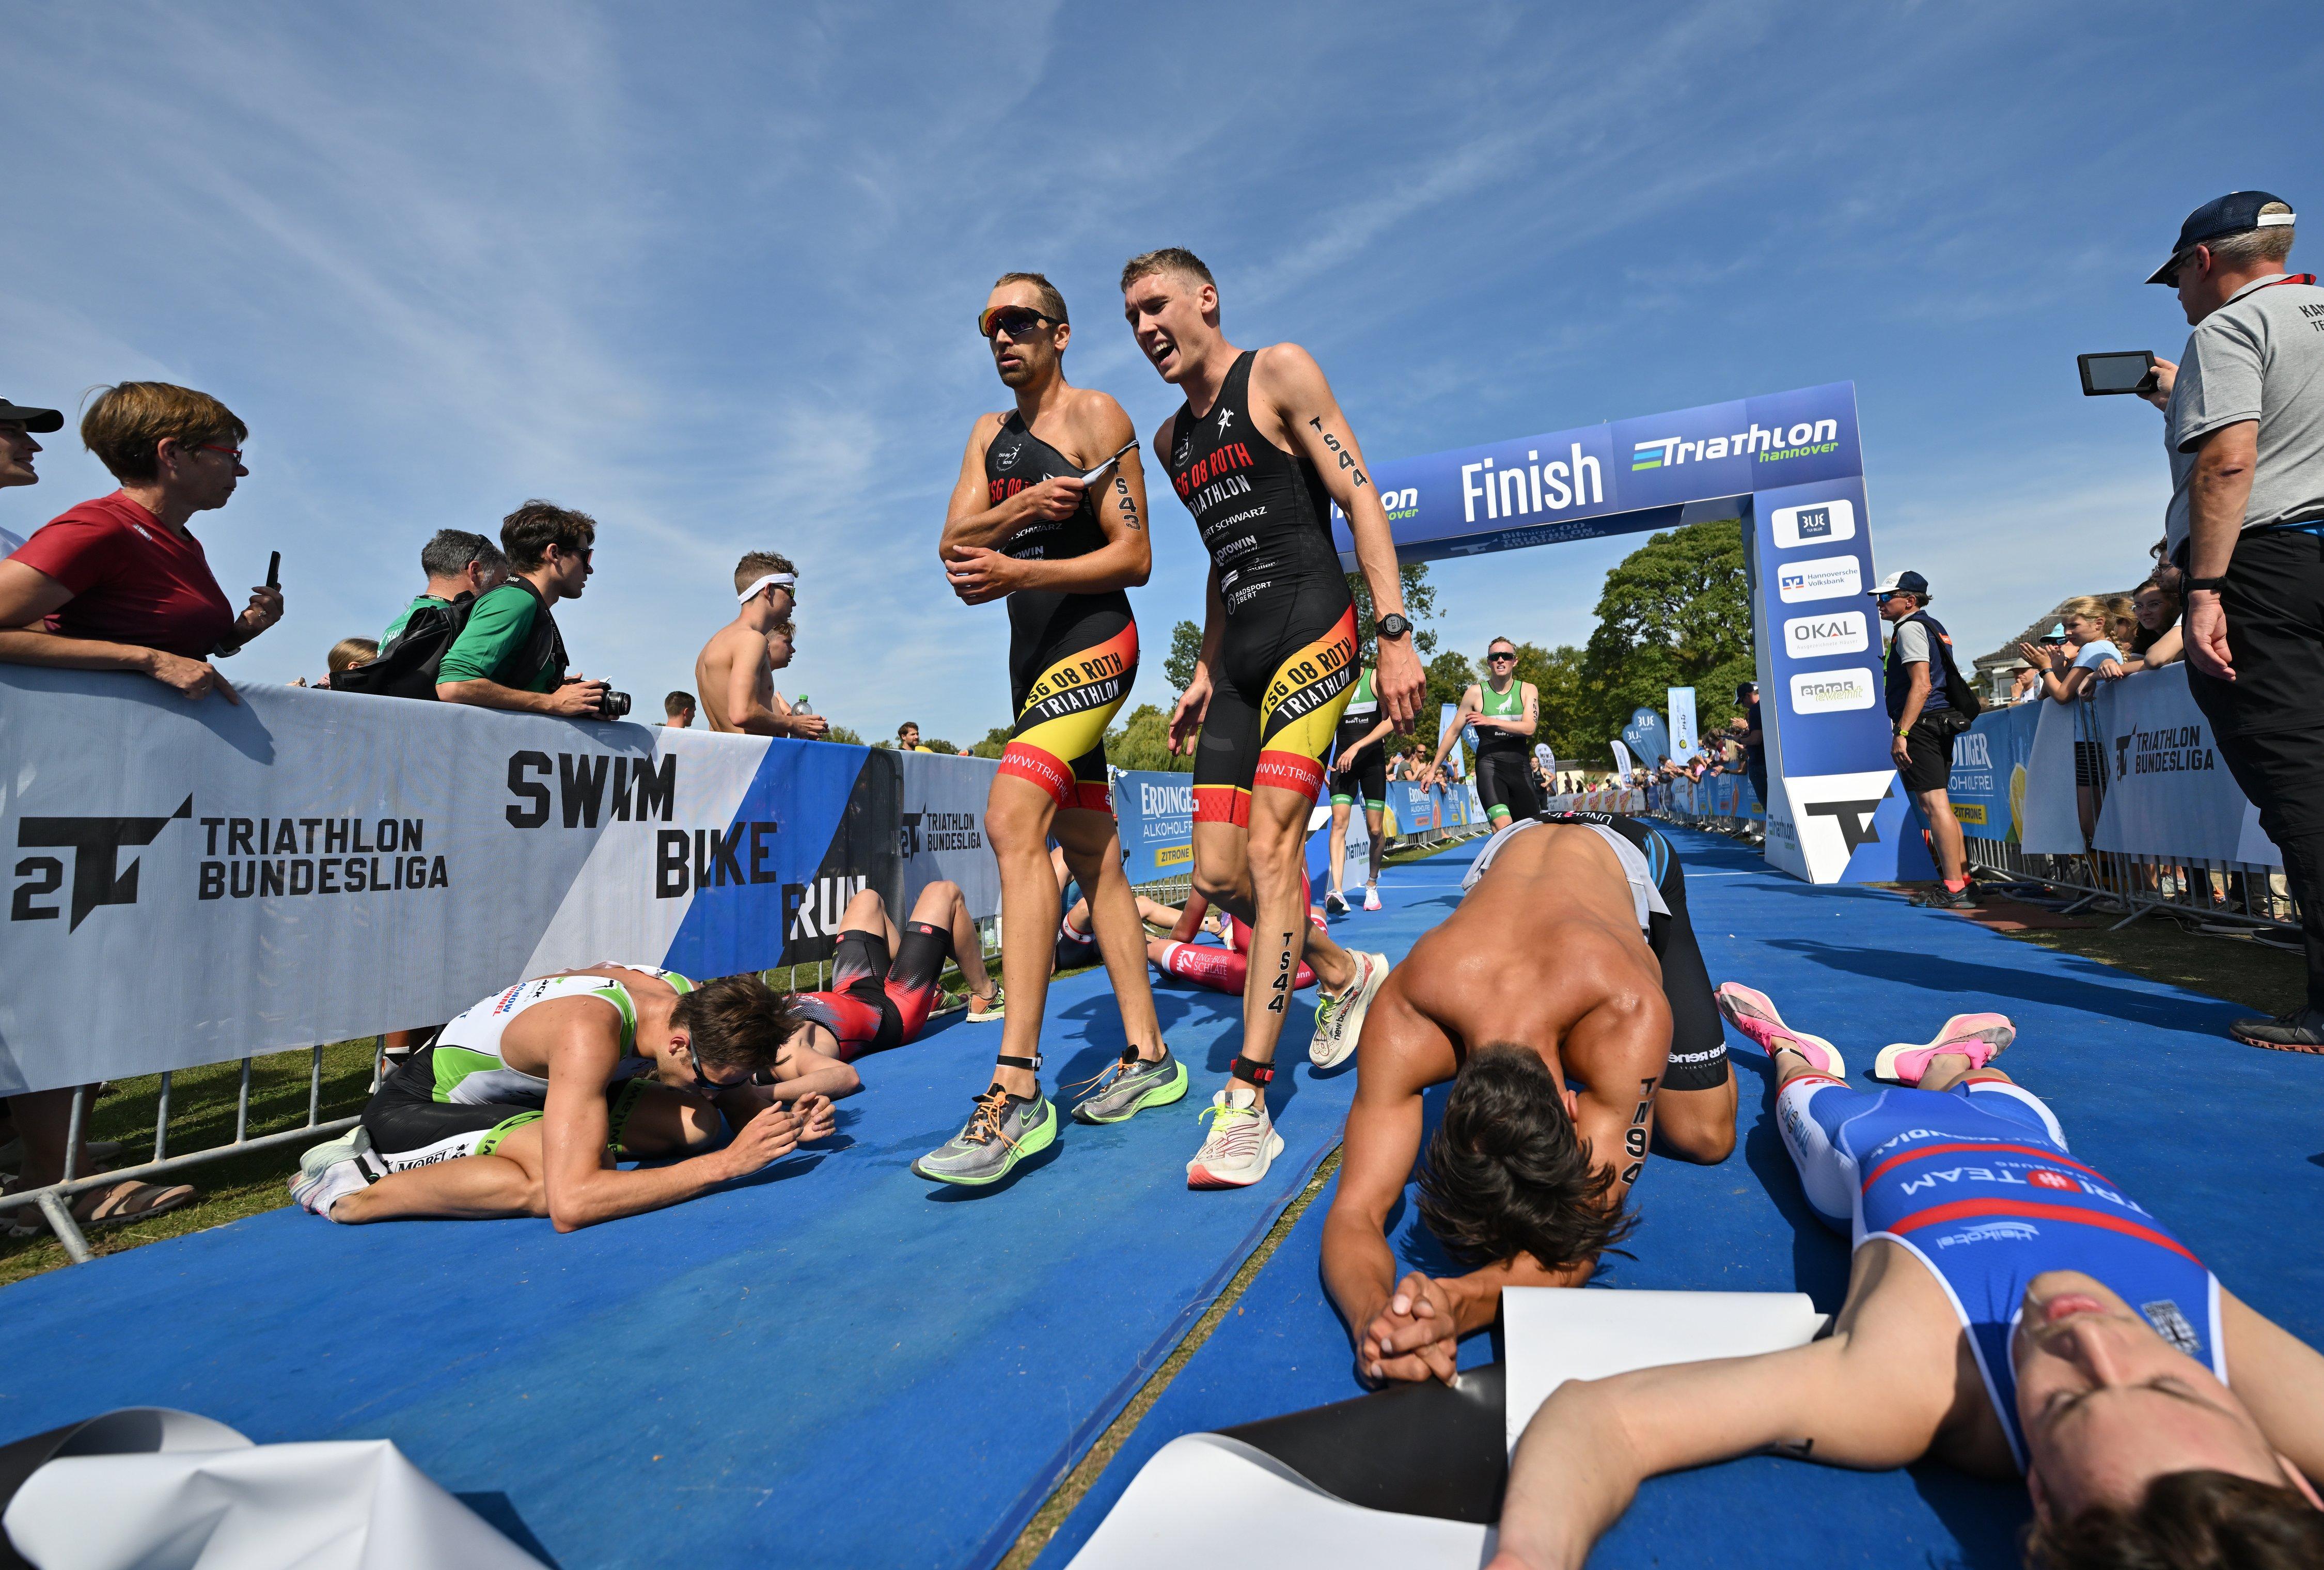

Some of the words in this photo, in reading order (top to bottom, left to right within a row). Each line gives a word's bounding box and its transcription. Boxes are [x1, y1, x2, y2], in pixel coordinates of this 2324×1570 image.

[1635, 419, 1837, 466] Triathlon
[1759, 441, 1839, 463] hannover
[1174, 472, 1189, 499] SG
[1191, 459, 1207, 488] 08
[1210, 443, 1253, 476] ROTH
[1462, 443, 1603, 523] Finish
[989, 478, 1004, 503] SG
[1015, 523, 1062, 539] SCHWARZ
[1215, 506, 1267, 531] SCHWARZ
[1501, 527, 1593, 547] TRIATHLON
[1808, 569, 1858, 579] Hannoversche
[1808, 577, 1844, 587] Volksbank
[1235, 581, 1271, 598] RADSPORT
[1236, 591, 1257, 604] IBERT
[1795, 621, 1856, 640] OKAL
[1051, 668, 1081, 688] 08
[1079, 652, 1123, 680] ROTH
[1263, 681, 1289, 715] TSG
[1287, 661, 1317, 685] 08
[1315, 637, 1353, 672] ROTH
[1035, 679, 1119, 718] TRIATHLON
[1276, 666, 1350, 719] TRIATHLON
[1802, 681, 1853, 696] eichels
[1815, 686, 1863, 701] event
[2137, 726, 2200, 752] TRIATHLON
[2135, 749, 2214, 774] BUNDESLIGA
[506, 750, 677, 828] SWIM
[1140, 783, 1192, 818] ERDINGE
[927, 813, 975, 831] TRIATHLON
[1954, 806, 1982, 820] ZITRONE
[200, 818, 423, 856] TRIATHLON
[928, 832, 981, 852] BUNDESLIGA
[1345, 838, 1369, 860] riathlon
[656, 822, 777, 899] BIKE
[1161, 848, 1189, 862] ZITRONE
[198, 855, 449, 901] BUNDESLIGA
[1334, 1022, 1343, 1040] new
[1340, 991, 1358, 1022] balance
[1901, 1166, 2028, 1196] TEAM
